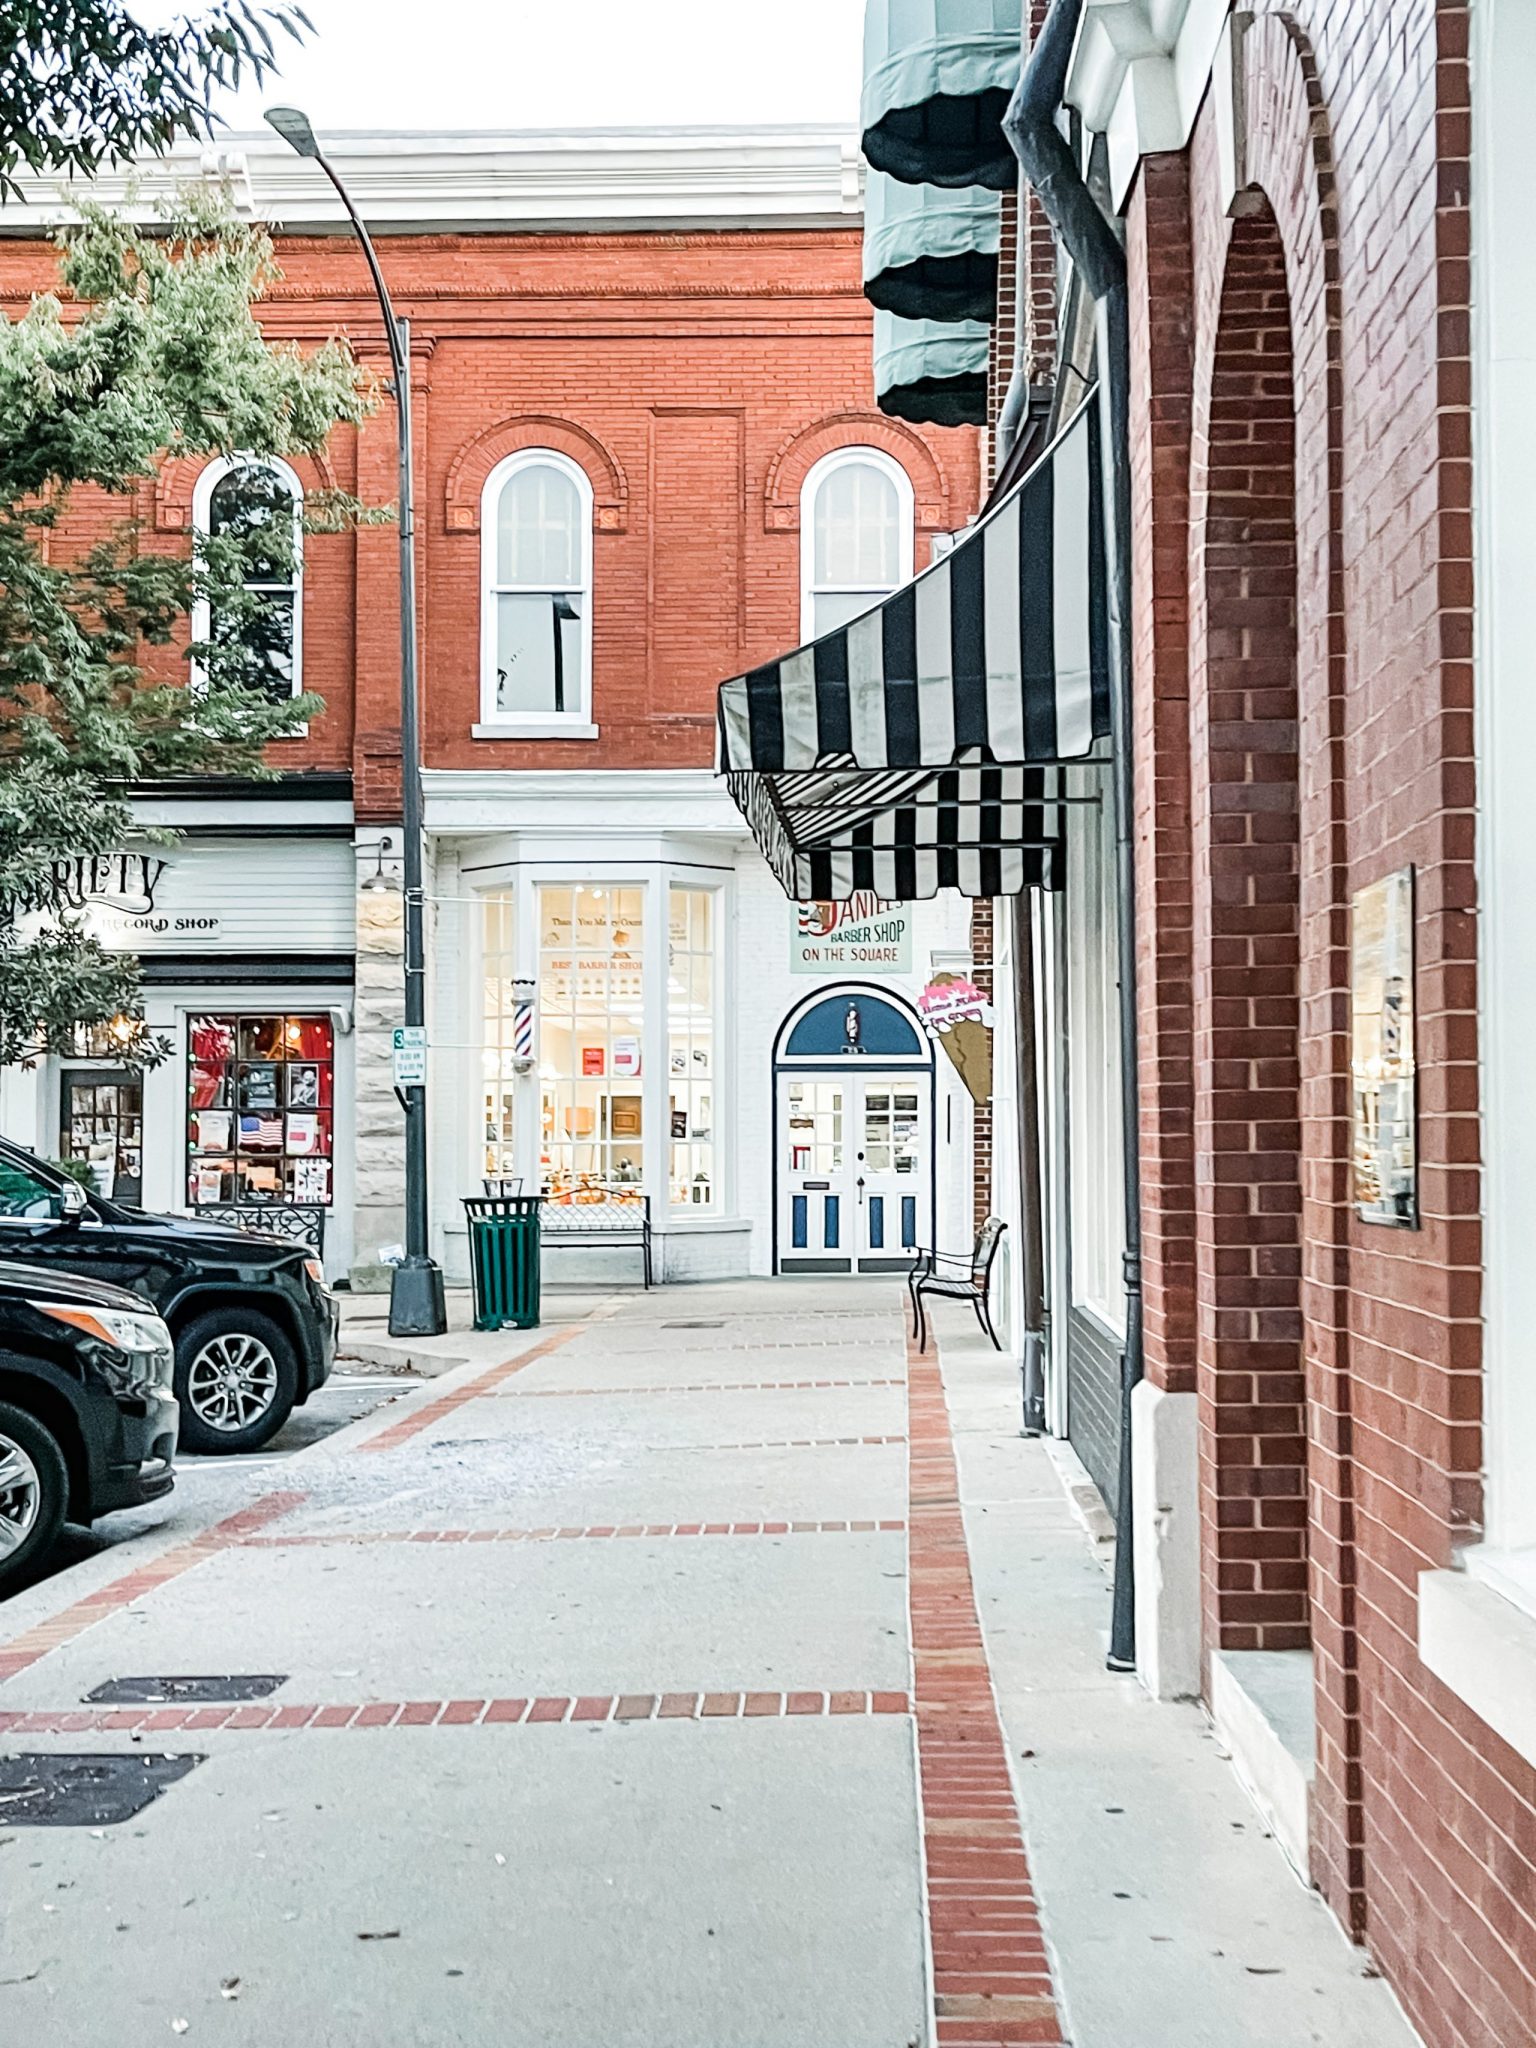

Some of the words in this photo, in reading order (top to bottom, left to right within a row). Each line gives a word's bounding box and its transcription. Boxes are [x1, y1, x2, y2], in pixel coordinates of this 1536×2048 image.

[174, 918, 219, 931] SHOP
[552, 917, 572, 926] Than
[577, 917, 593, 926] You
[594, 917, 619, 928] Mary
[830, 926, 871, 943] BARBER
[874, 920, 905, 943] SHOP
[802, 948, 820, 961] ON
[824, 948, 845, 961] THE
[851, 948, 899, 962] SQUARE
[394, 1031, 404, 1048] 3
